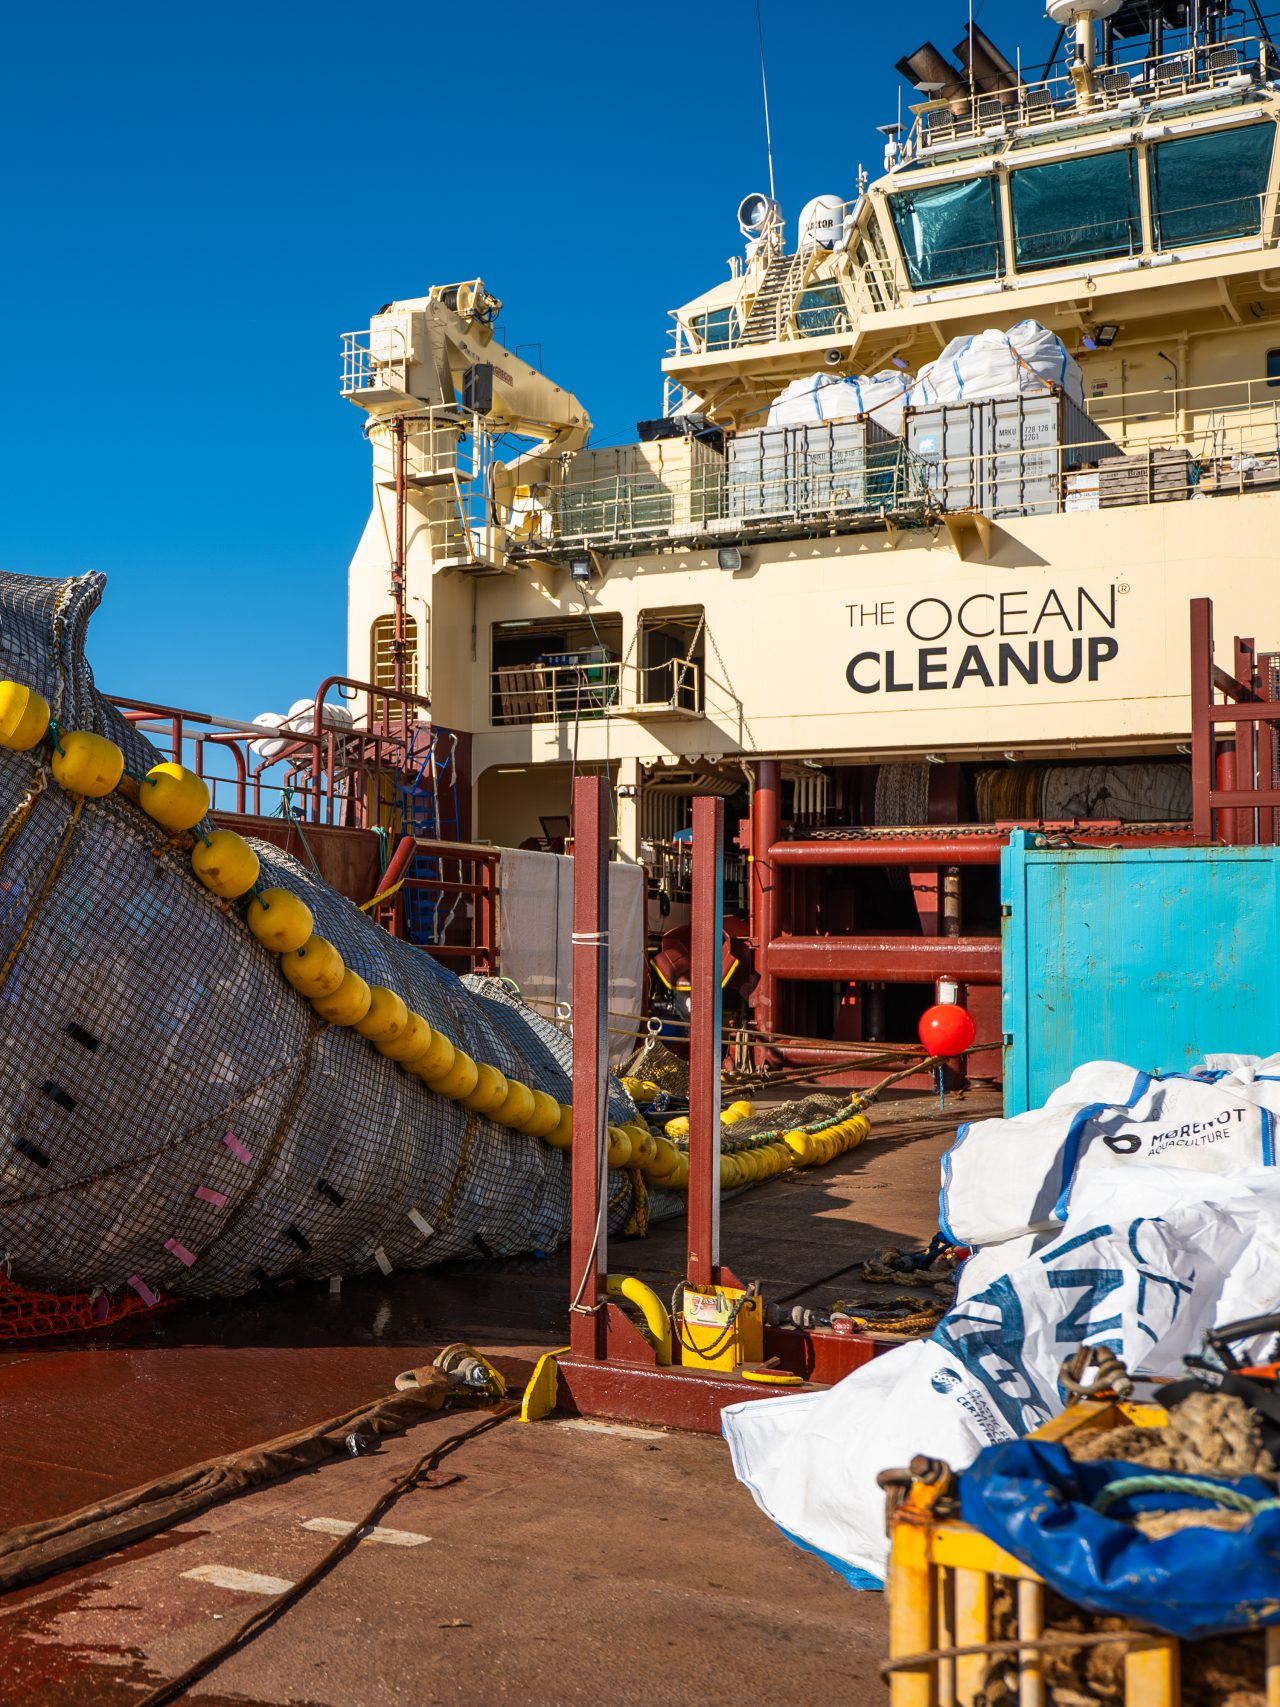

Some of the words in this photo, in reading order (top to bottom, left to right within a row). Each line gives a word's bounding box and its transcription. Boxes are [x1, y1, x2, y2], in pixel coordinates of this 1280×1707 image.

[806, 219, 834, 231] ALOR
[999, 428, 1017, 437] MRKU
[845, 601, 895, 628] THE
[906, 584, 1116, 642] OCEAN
[846, 636, 1119, 694] CLEANUP
[1148, 1128, 1230, 1157] AQUACULTURE
